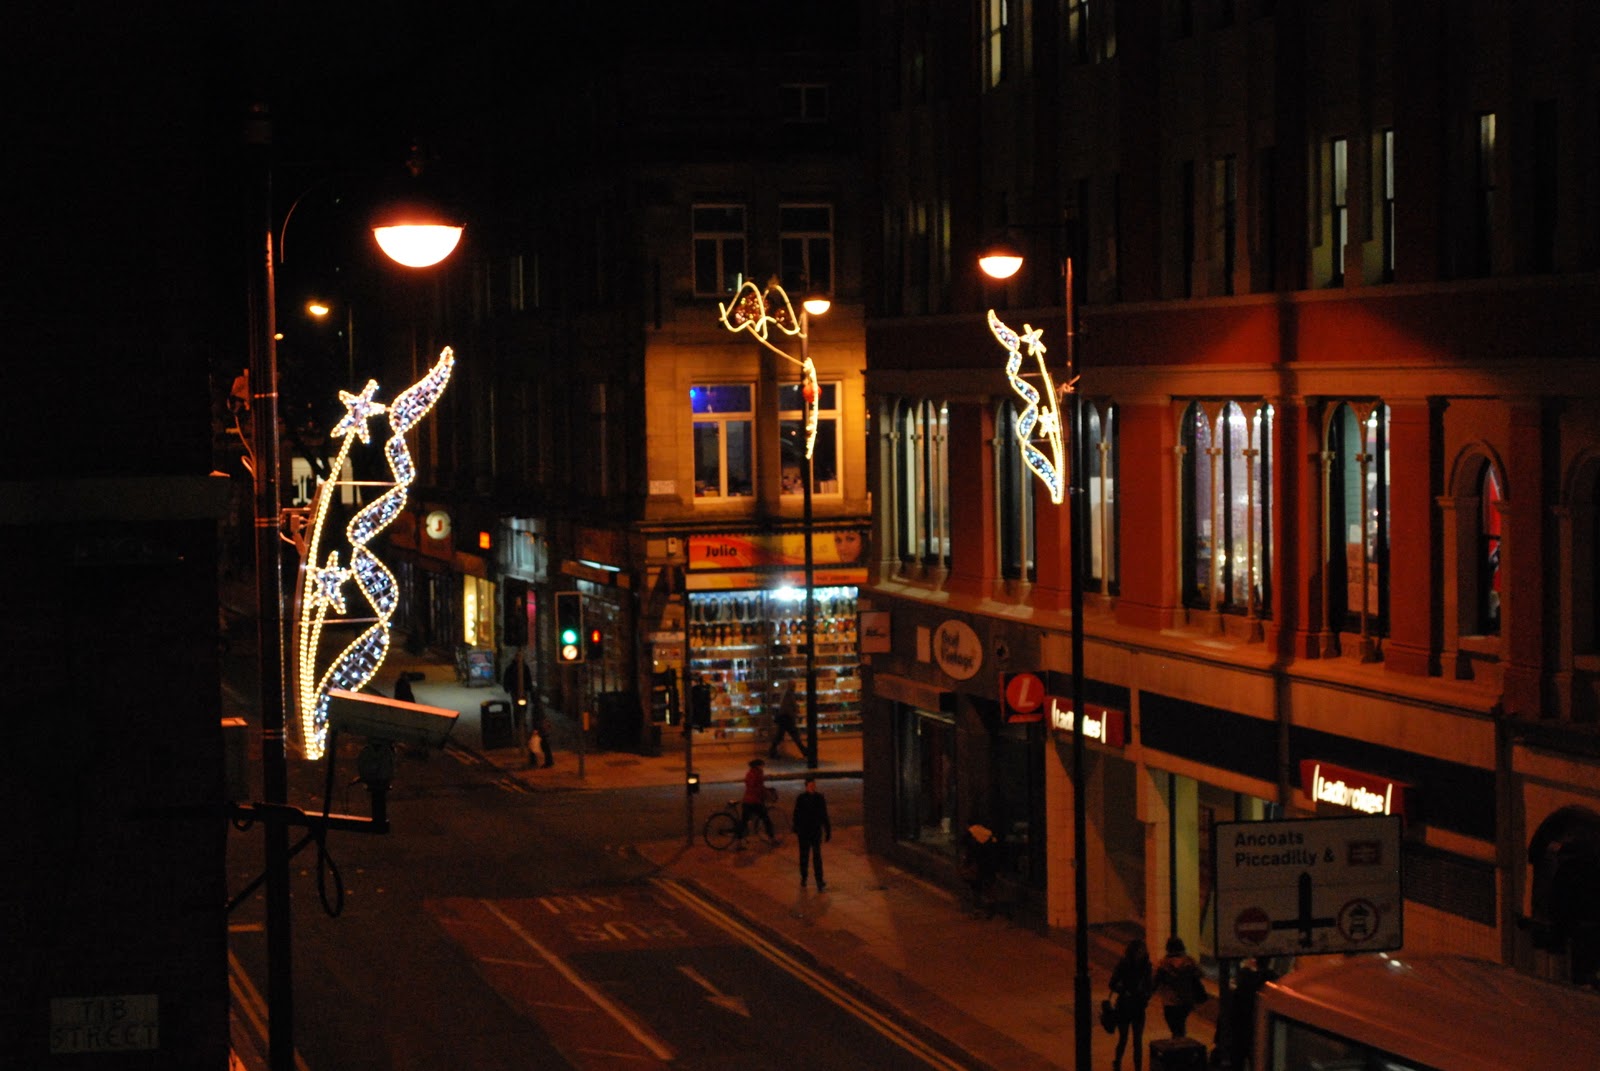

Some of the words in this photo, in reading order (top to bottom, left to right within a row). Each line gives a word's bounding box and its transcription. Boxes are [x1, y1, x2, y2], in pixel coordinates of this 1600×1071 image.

[1017, 677, 1036, 708] L
[1317, 776, 1385, 814] Ladbrokes
[1234, 831, 1305, 847] Ancoats
[1234, 850, 1317, 867] Piccadilly
[1323, 849, 1335, 863] &
[82, 999, 128, 1020] TIB
[54, 1024, 157, 1049] STREET
